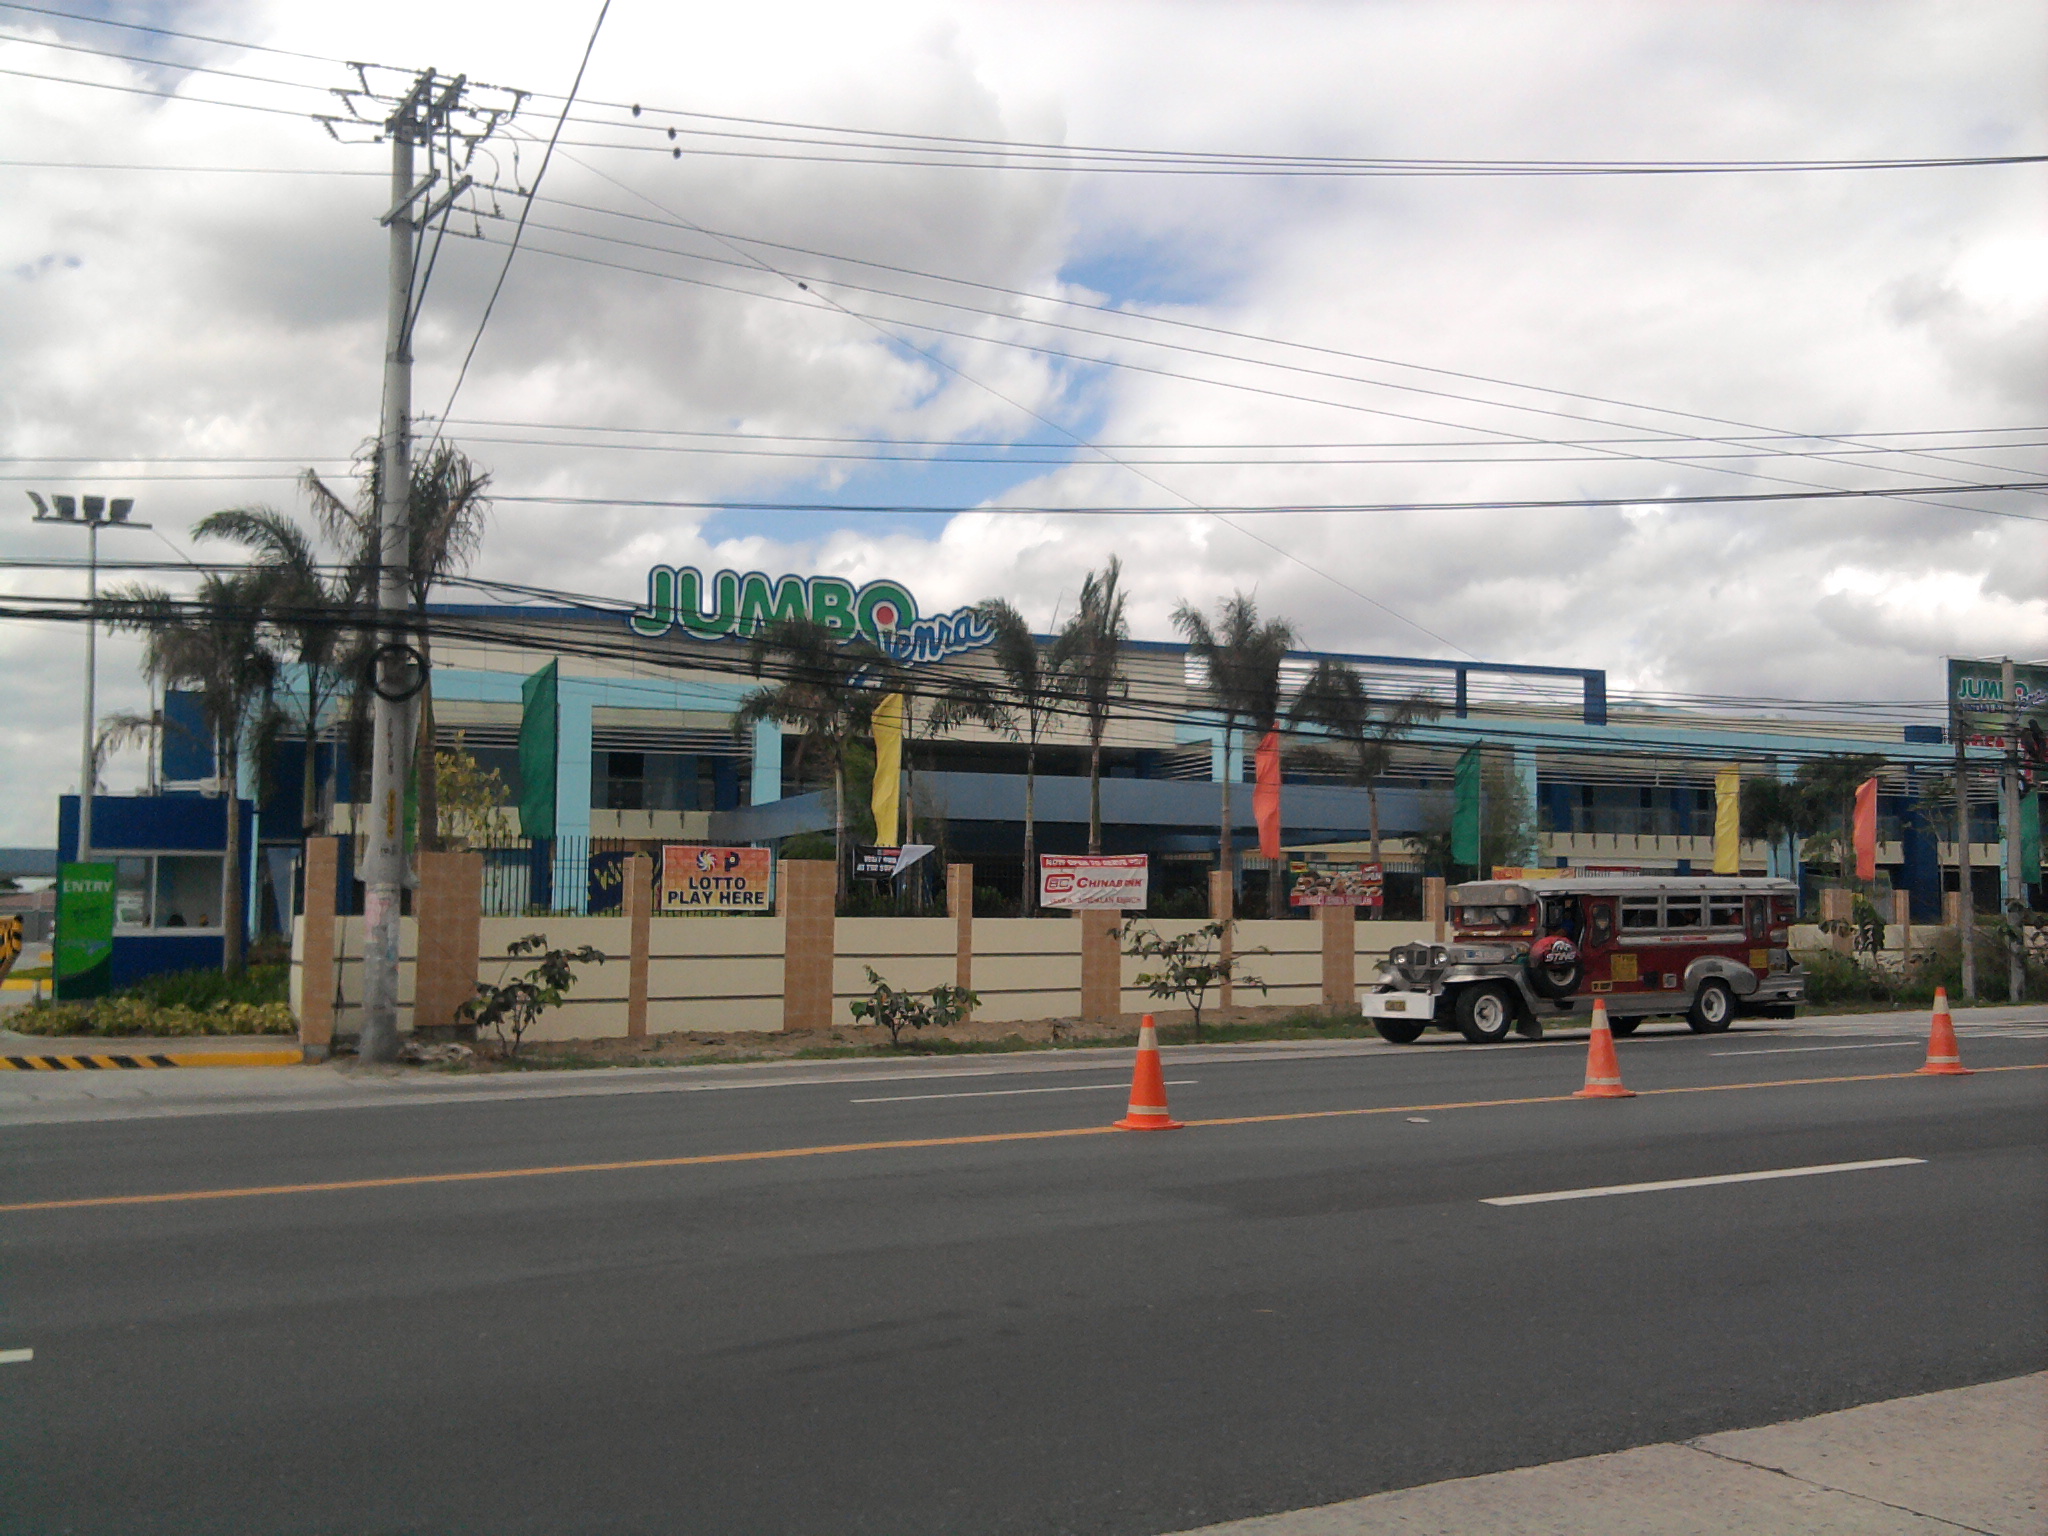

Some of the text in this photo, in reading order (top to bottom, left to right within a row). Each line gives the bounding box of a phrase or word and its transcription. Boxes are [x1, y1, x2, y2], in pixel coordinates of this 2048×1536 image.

[629, 564, 919, 644] JUMBO
[1958, 678, 2028, 701] JUMO
[63, 879, 112, 892] ENTRY
[689, 876, 746, 890] LOTTO
[668, 891, 765, 904] PLAY HERE
